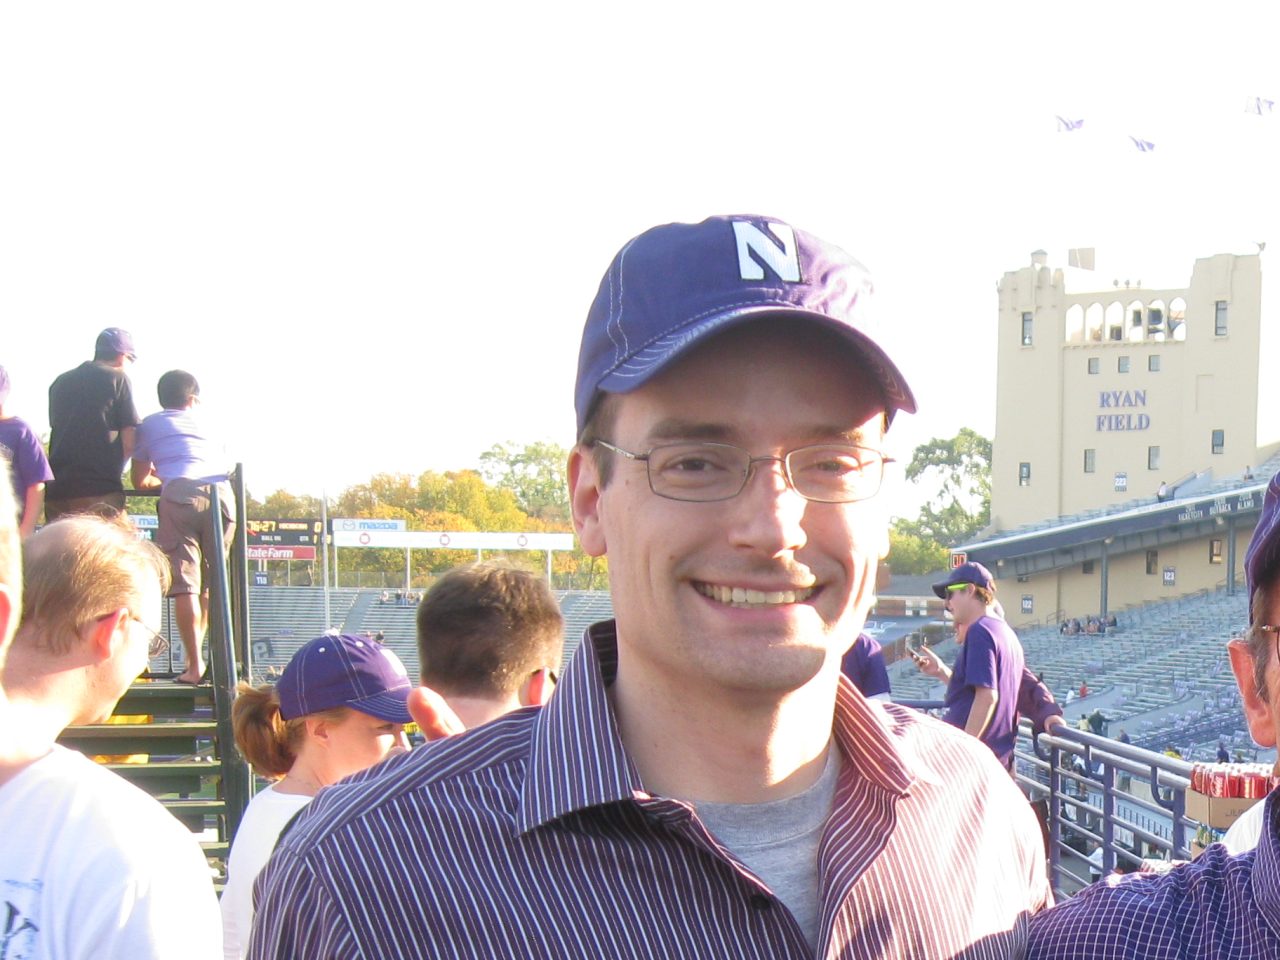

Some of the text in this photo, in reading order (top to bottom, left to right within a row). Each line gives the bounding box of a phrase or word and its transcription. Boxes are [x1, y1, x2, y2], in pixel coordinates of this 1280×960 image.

[731, 221, 801, 282] N
[1099, 389, 1146, 408] RYAN
[1096, 413, 1150, 431] FIELD
[359, 522, 398, 531] mazda
